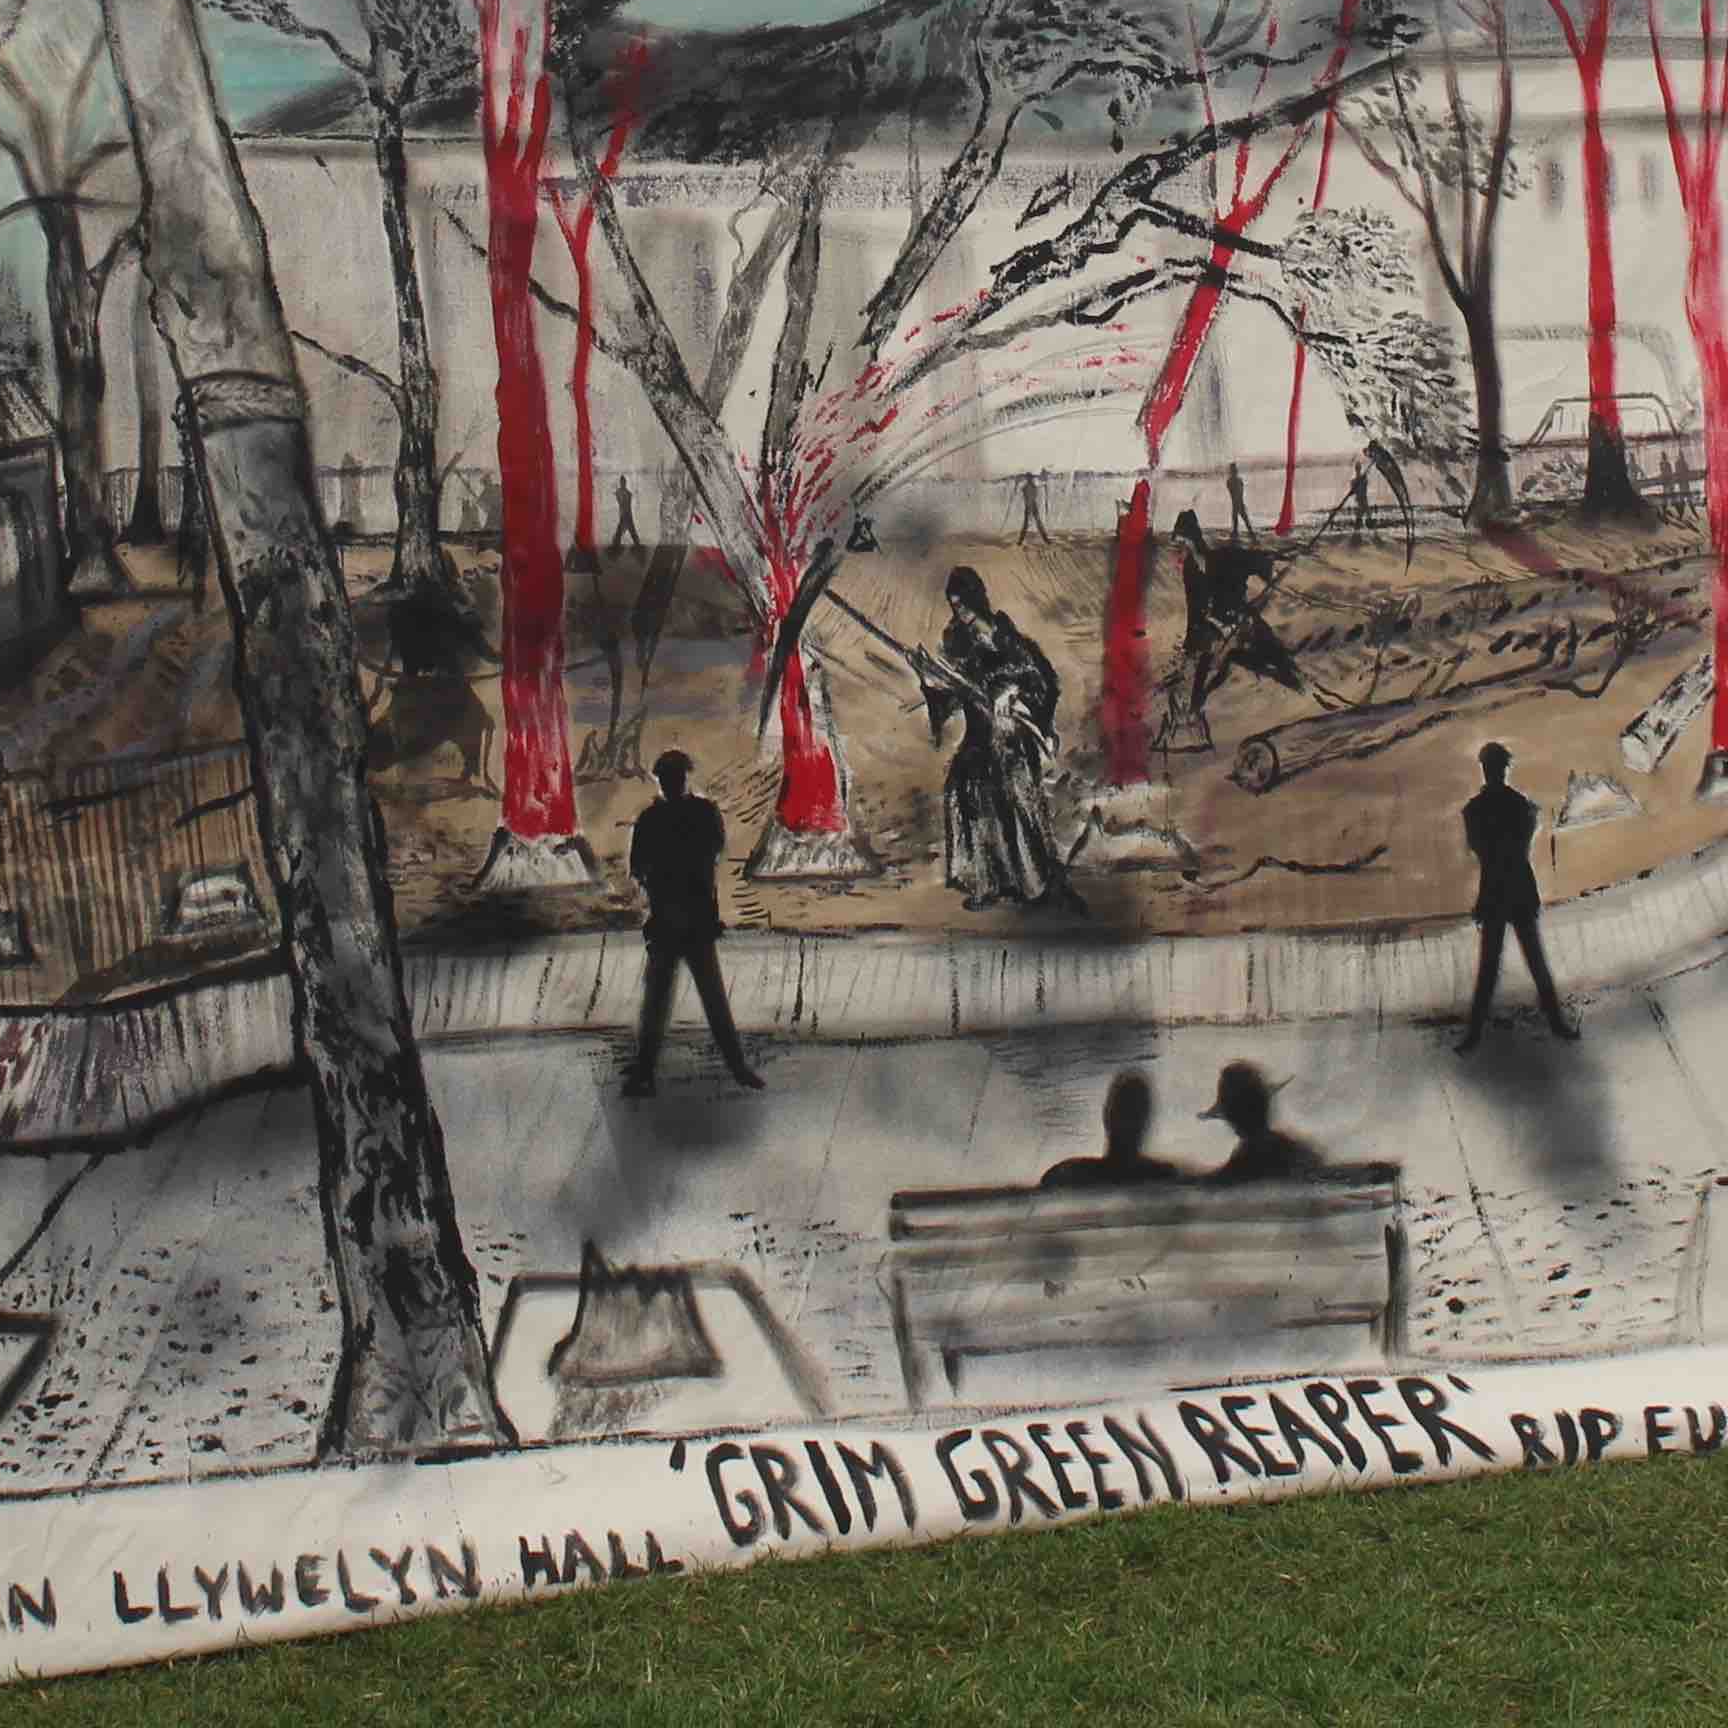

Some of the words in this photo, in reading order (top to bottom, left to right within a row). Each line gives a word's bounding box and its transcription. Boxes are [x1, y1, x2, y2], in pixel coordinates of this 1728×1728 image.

[112, 1534, 482, 1626] LLYWELYN
[518, 1528, 686, 1590] HALL
[935, 1409, 1192, 1527] GREEN
[1510, 1407, 1625, 1467] RIP
